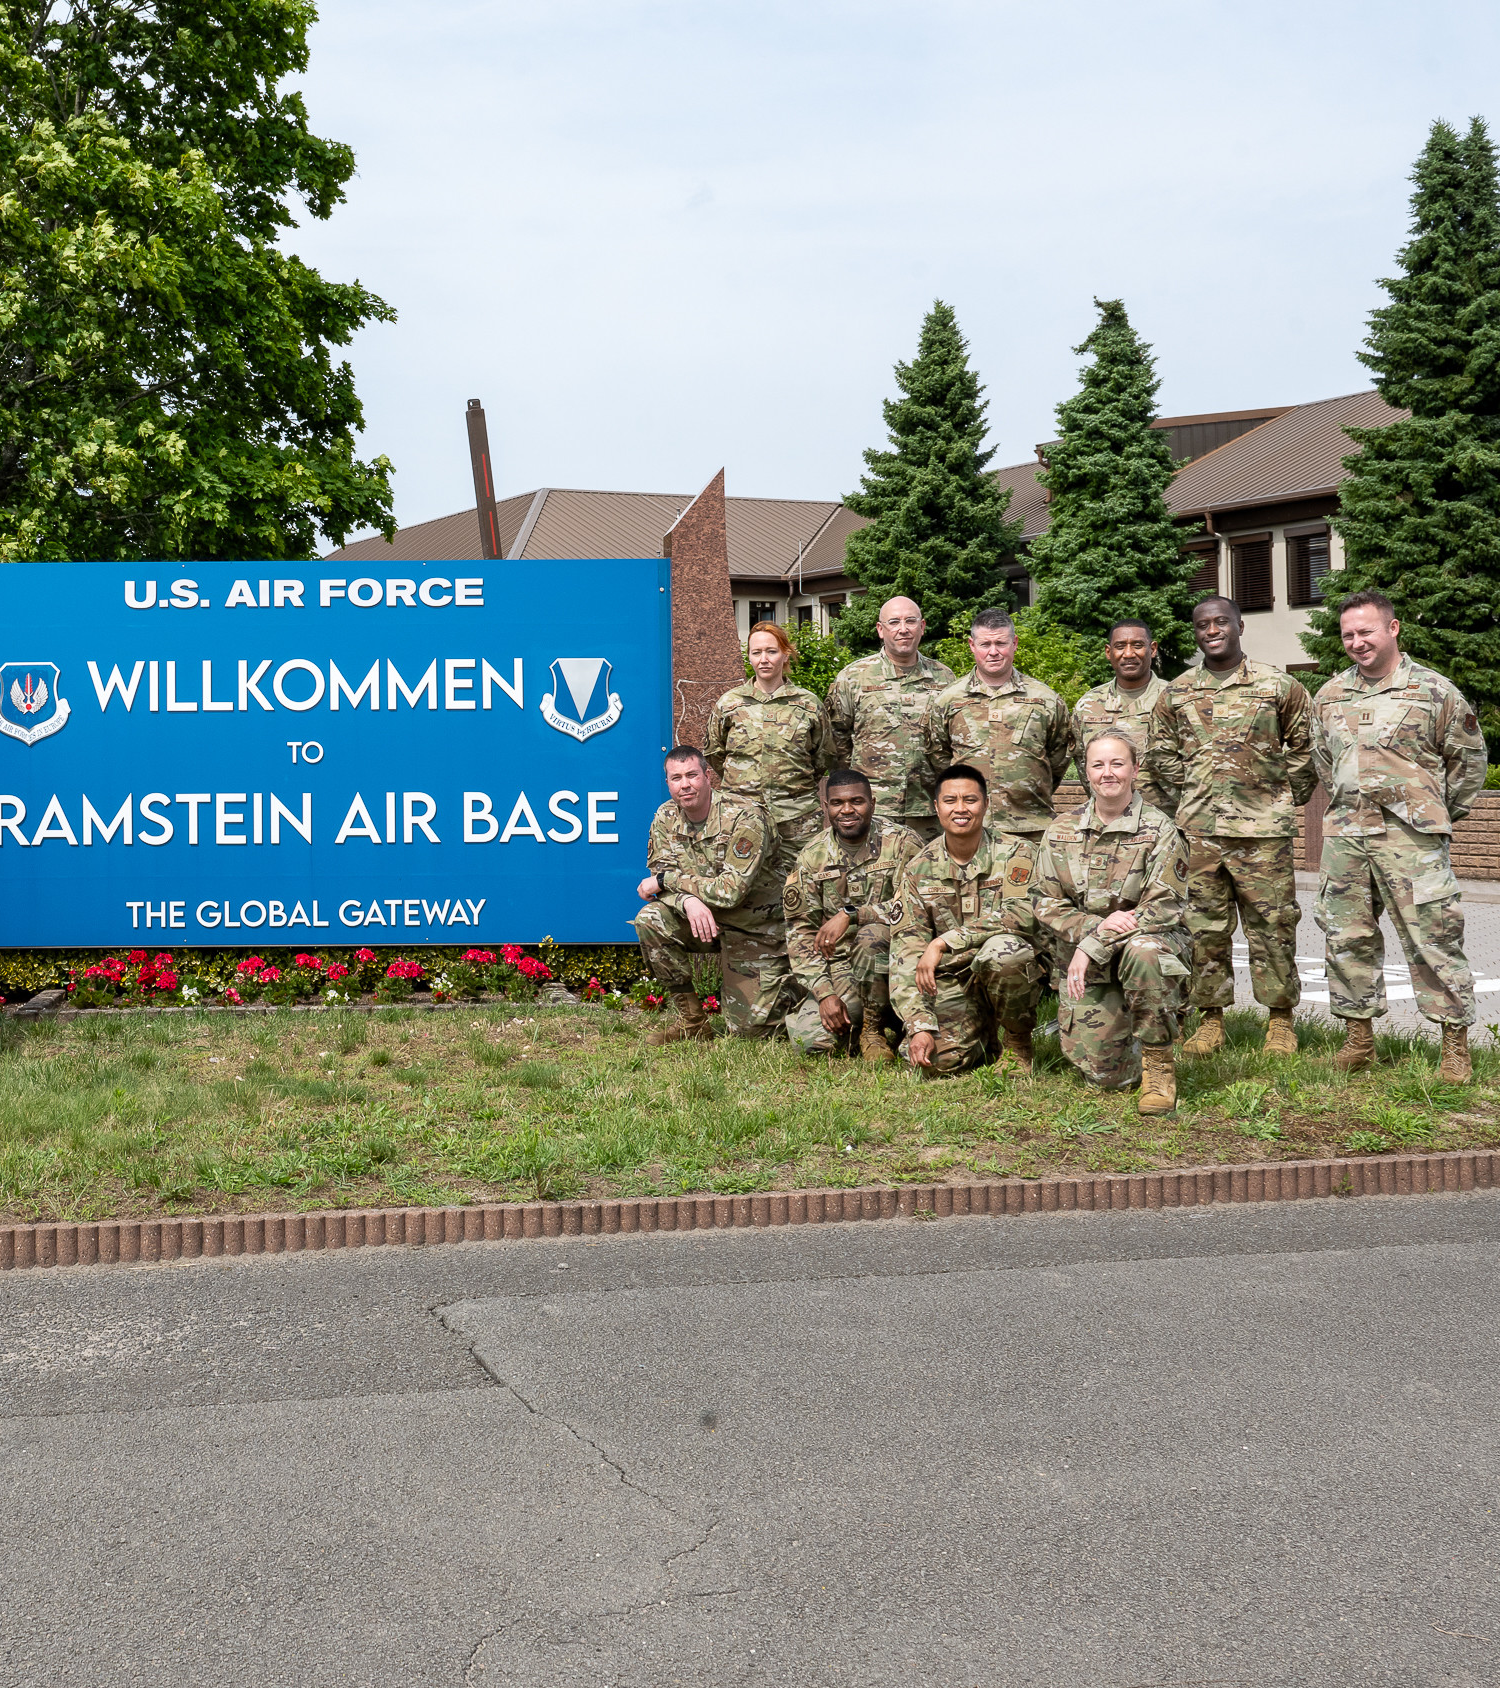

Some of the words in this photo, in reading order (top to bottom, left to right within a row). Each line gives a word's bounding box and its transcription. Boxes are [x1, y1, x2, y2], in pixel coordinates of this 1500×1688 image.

[124, 579, 211, 608] U.S.
[225, 579, 305, 608] AIR
[319, 577, 485, 607] FORCE
[86, 657, 525, 713] WILLKOMMEN
[549, 713, 576, 732] VIRTUS
[576, 713, 615, 738] PERDURAT
[286, 740, 324, 765] TO
[334, 791, 442, 845] AIR
[463, 789, 620, 844] BASE
[879, 860, 895, 870] FORCE
[125, 900, 186, 928] THE
[195, 899, 330, 928] GLOBAL
[338, 898, 488, 928] GATEWAY
